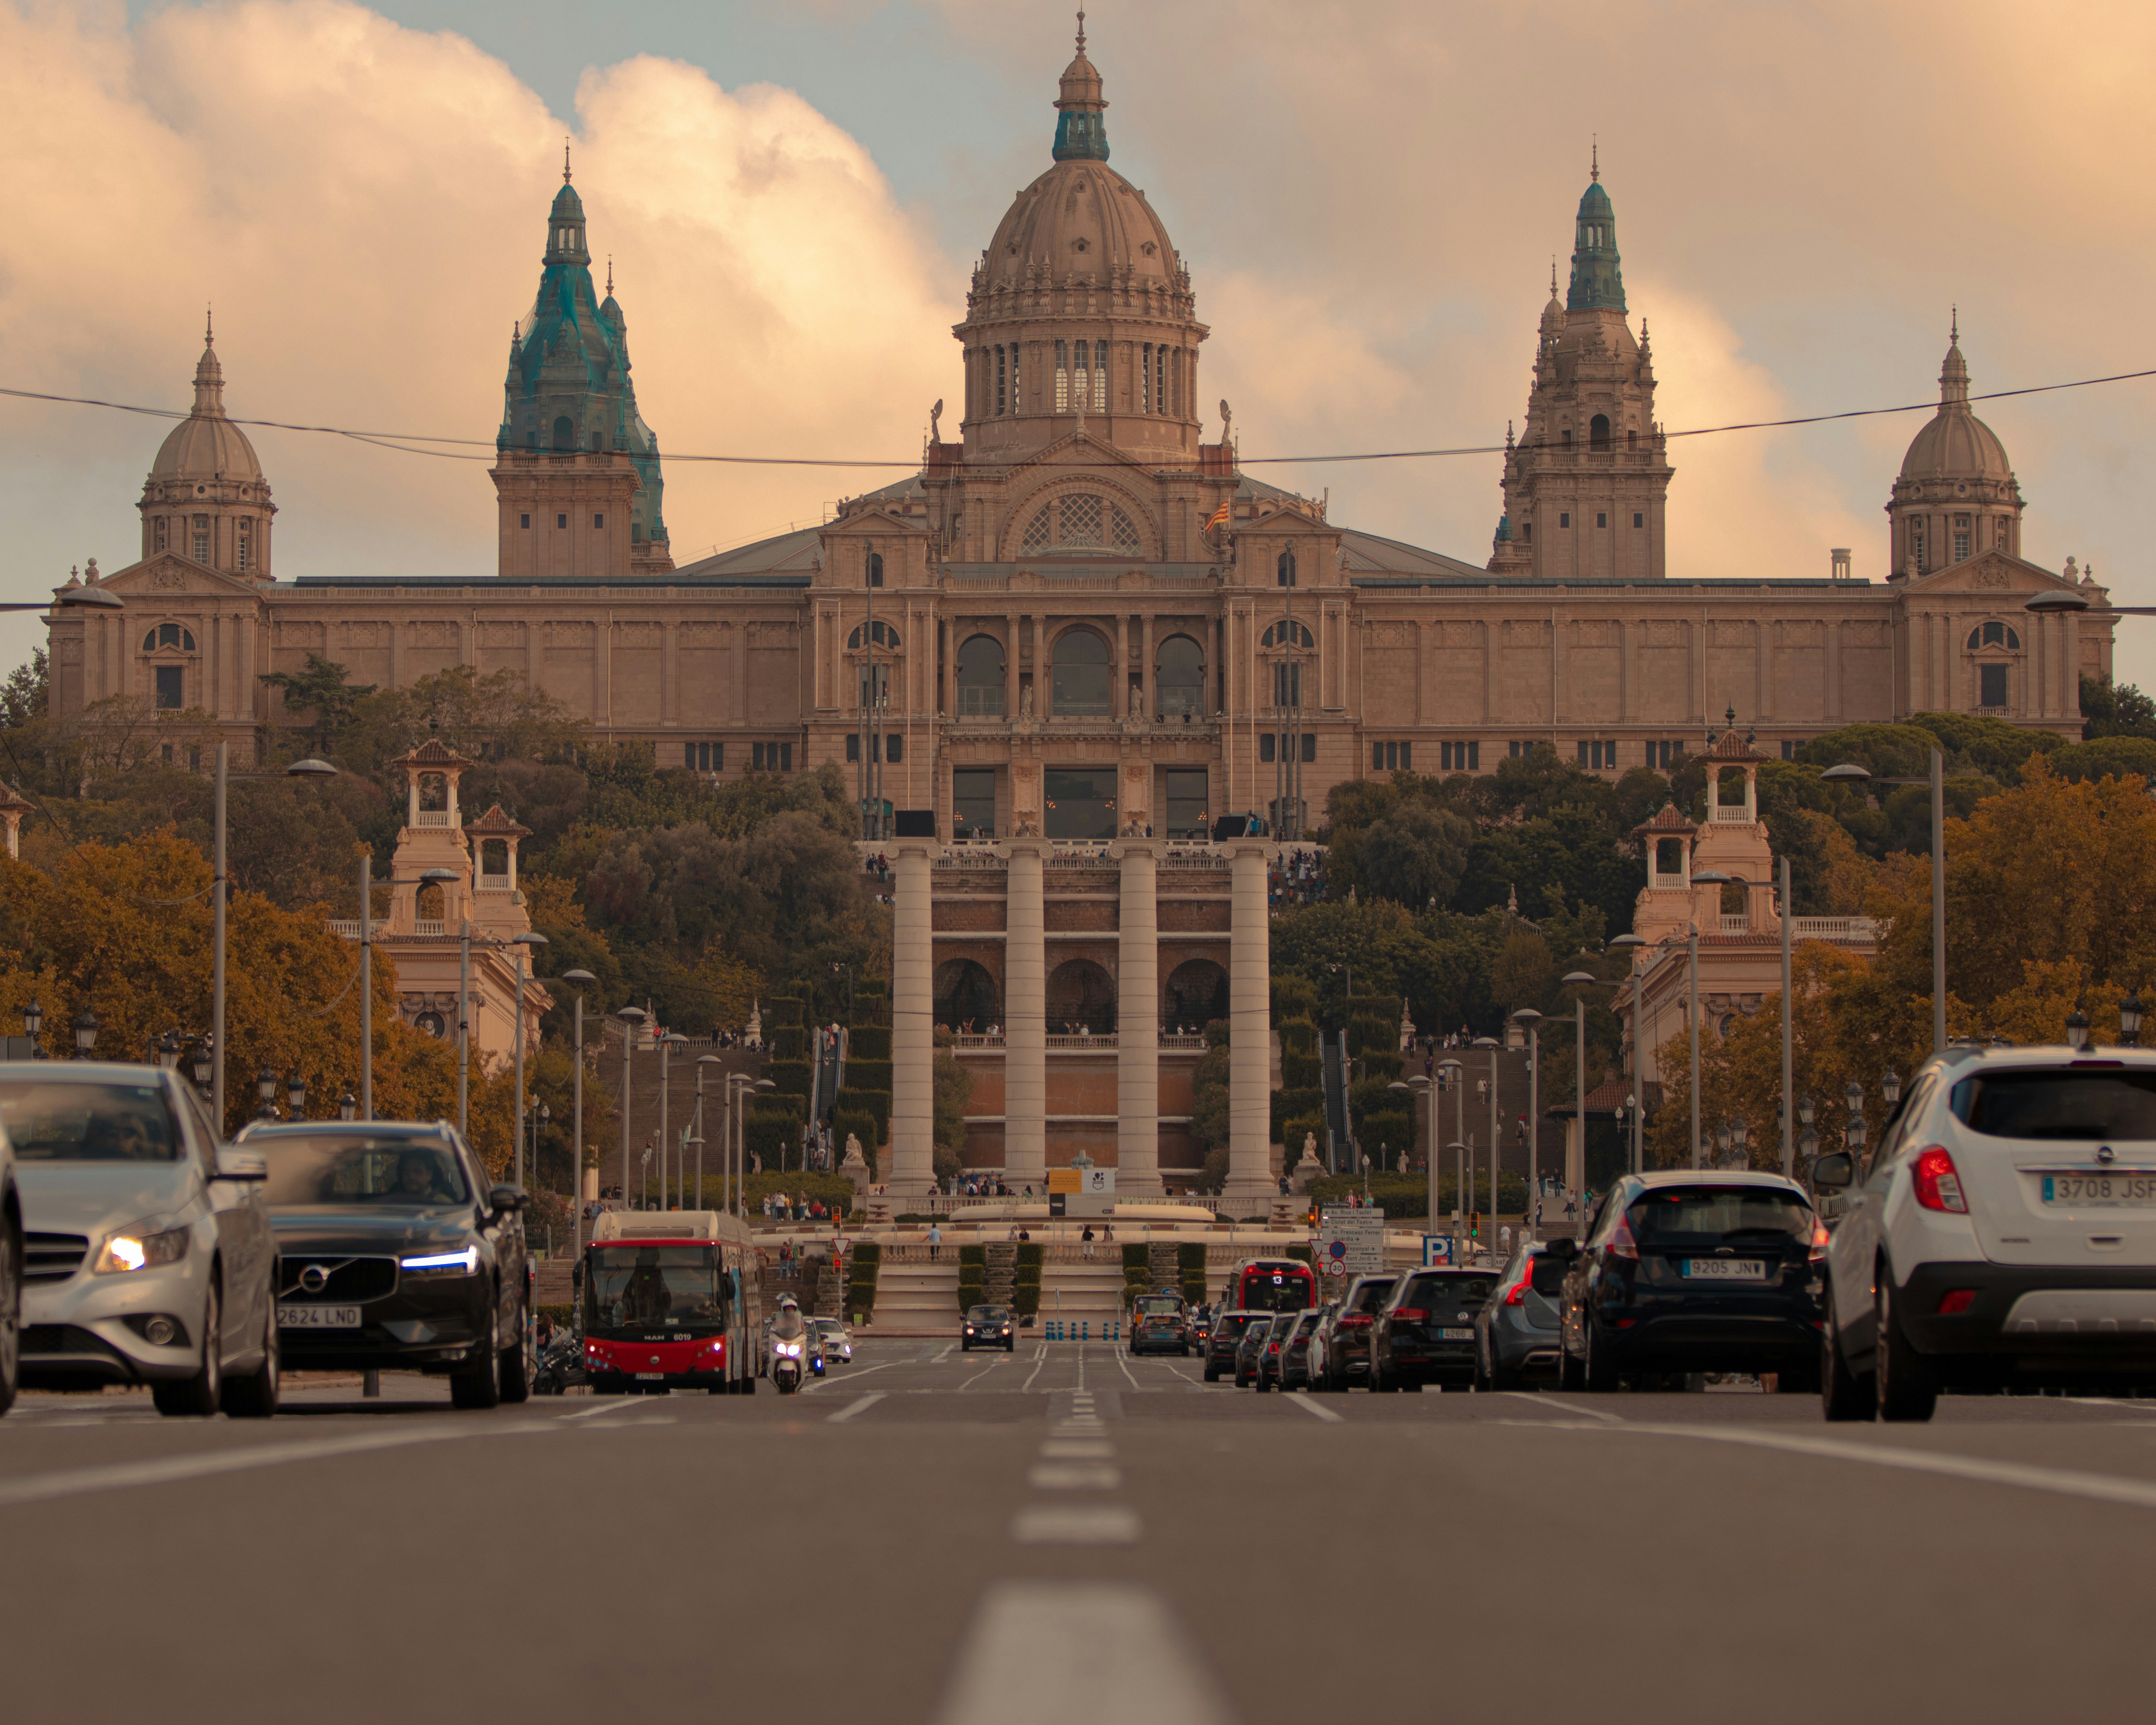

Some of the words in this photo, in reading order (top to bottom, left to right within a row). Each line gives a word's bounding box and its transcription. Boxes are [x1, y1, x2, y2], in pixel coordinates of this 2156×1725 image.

[2059, 1180, 2112, 1198] 3708
[1427, 1238, 1448, 1265] P
[1693, 1262, 1728, 1274] 9205
[1273, 1276, 1282, 1284] 13
[278, 1310, 318, 1324] 2624
[326, 1310, 356, 1324] LND
